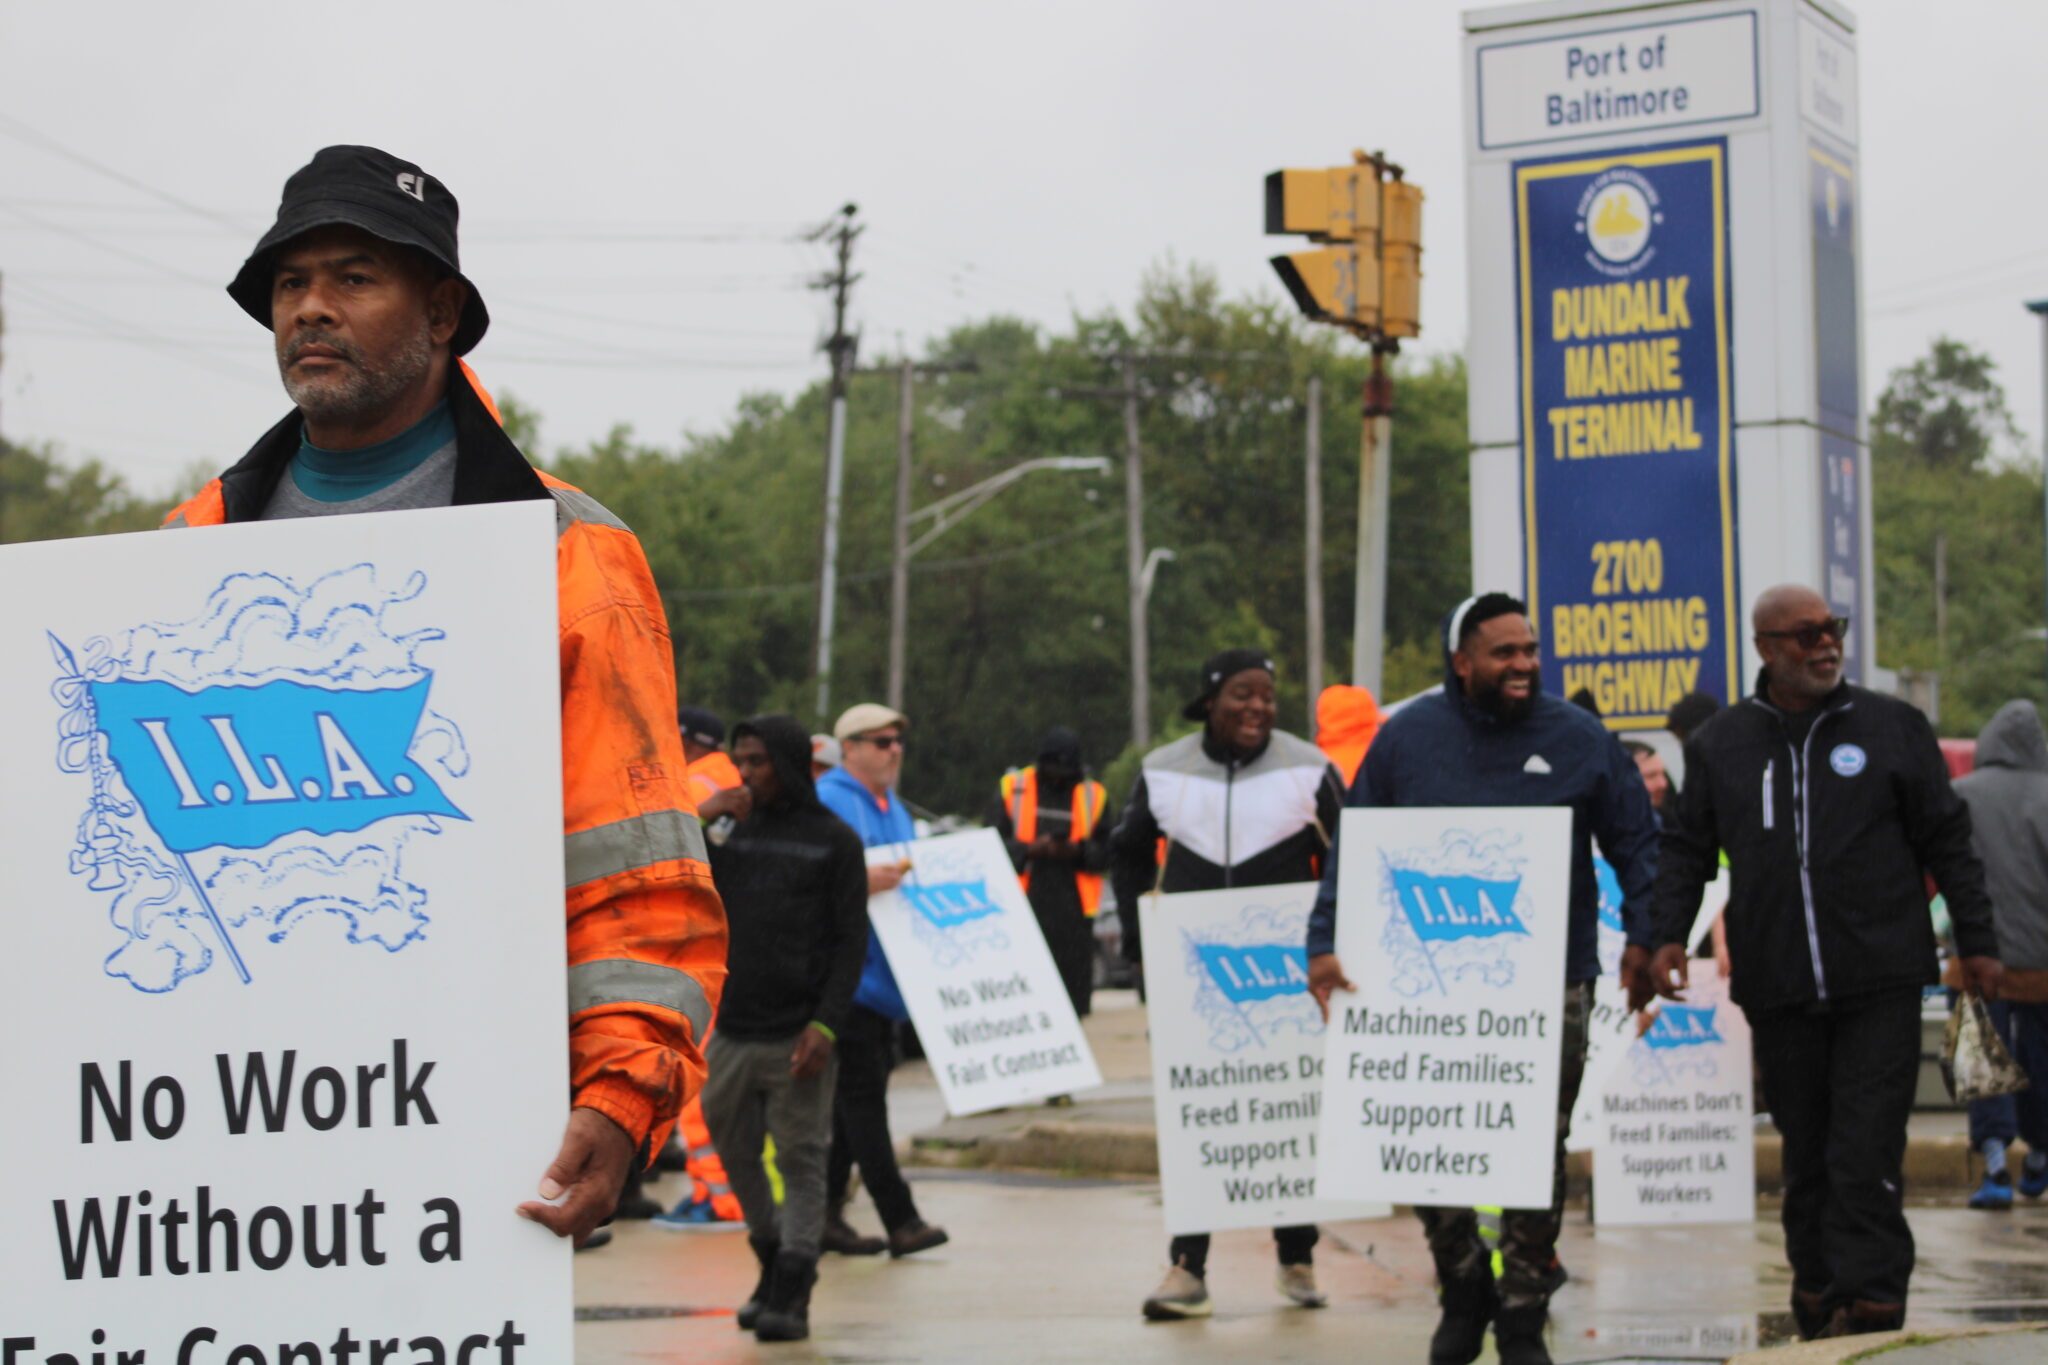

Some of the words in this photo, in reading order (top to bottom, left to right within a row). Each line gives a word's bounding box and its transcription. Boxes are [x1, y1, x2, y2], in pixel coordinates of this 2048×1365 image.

[1566, 44, 1628, 80] Port
[1638, 36, 1666, 71] of
[1546, 85, 1689, 127] Baltimore
[1552, 276, 1691, 341] DUNDALK
[1564, 339, 1682, 398] MARINE
[1548, 398, 1702, 460] TERMINAL
[1591, 539, 1663, 595] 2700
[1552, 596, 1709, 658] BROENING
[1562, 657, 1700, 715] HIGHWAY
[134, 713, 415, 808] I.L.A.
[1412, 886, 1514, 926] I.L.A.
[937, 987, 971, 1009] No
[973, 973, 1031, 1003] Work
[944, 1012, 1034, 1048] Without
[1039, 1011, 1053, 1030] a
[1344, 1006, 1467, 1037] Machines
[946, 1062, 988, 1088] Fair
[992, 1043, 1081, 1079] Contract
[1169, 1060, 1289, 1089] Machines
[1348, 1052, 1409, 1081] Feed
[1417, 1053, 1535, 1084] Families:
[80, 1059, 186, 1144] No
[215, 1038, 439, 1135] Work
[1603, 1093, 1689, 1114] Machines
[1181, 1099, 1239, 1128] Feed
[1361, 1097, 1465, 1136] Support
[1475, 1101, 1515, 1130] ILA
[1609, 1124, 1652, 1144] Feed
[1658, 1122, 1738, 1143] Families:
[1200, 1137, 1299, 1170] Support
[1380, 1144, 1490, 1176] Workers
[1622, 1154, 1693, 1179] Support
[1699, 1152, 1727, 1173] ILA
[1224, 1174, 1315, 1203] Worker
[1637, 1184, 1713, 1204] Workers
[52, 1185, 387, 1281] Without
[418, 1197, 462, 1264] a
